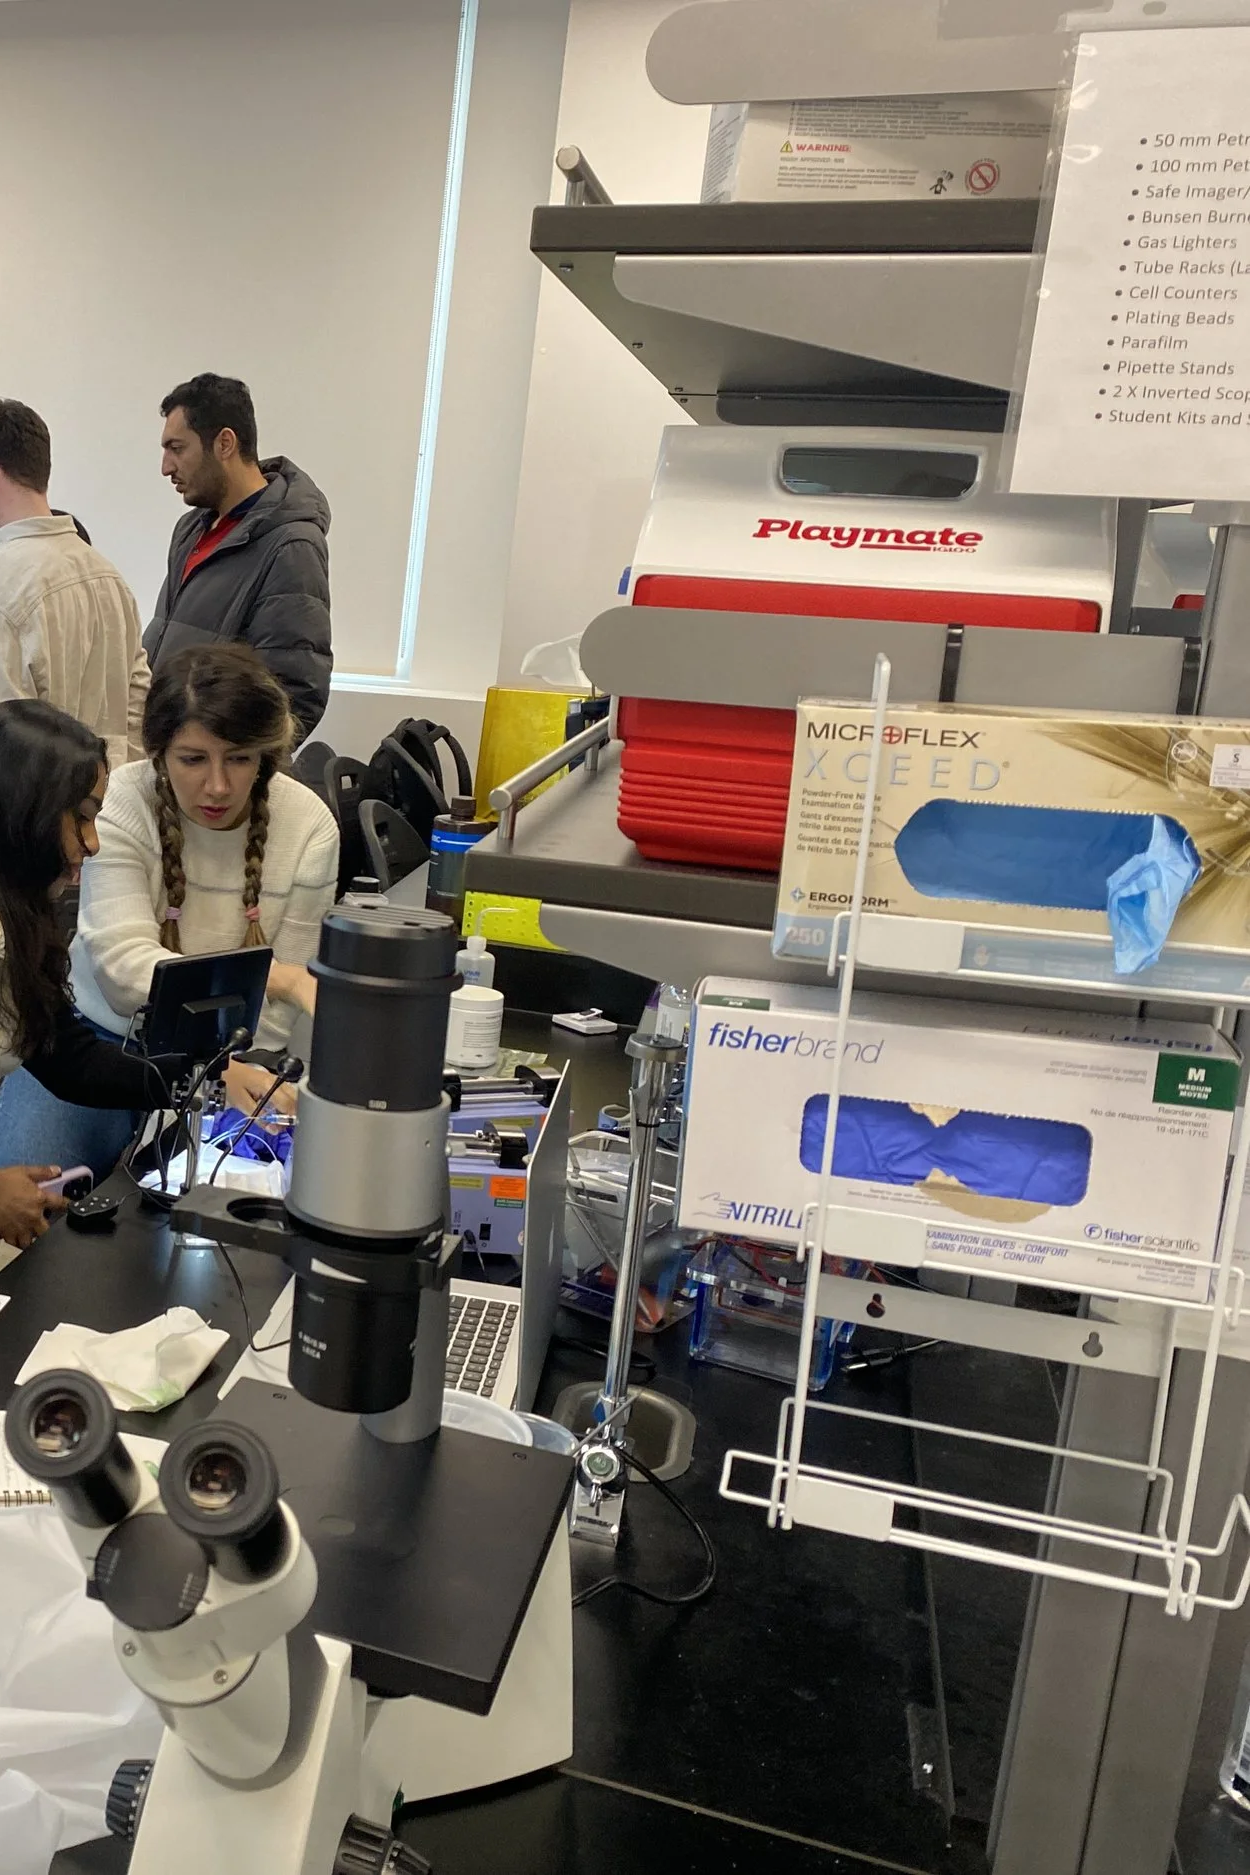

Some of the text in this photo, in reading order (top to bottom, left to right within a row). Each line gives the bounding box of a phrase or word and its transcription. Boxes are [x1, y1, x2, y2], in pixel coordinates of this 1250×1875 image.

[1153, 132, 1250, 148] 50 mm Petr
[1150, 158, 1250, 173] 100 mm Pet
[1145, 184, 1250, 201] Safe Imager/
[1142, 210, 1202, 224] Bunsen
[1137, 234, 1238, 252] Gas Lighters
[1134, 259, 1250, 277] Tube Racks (La
[1129, 285, 1238, 300] Cell Counters
[1125, 310, 1235, 327] Plating Beads
[1121, 334, 1188, 350] Parafilm
[1117, 360, 1235, 376] Pipette Stands
[1112, 385, 1122, 398] 2
[1127, 385, 1138, 398] X
[1142, 385, 1211, 400] Inverted
[1109, 409, 1172, 423] Student
[1177, 411, 1206, 425] Kits
[1211, 411, 1243, 425] and
[752, 518, 984, 549] Playmate
[804, 748, 1001, 792] XCEED
[802, 788, 854, 800] Powder-Free
[801, 798, 851, 809] Examination
[800, 811, 822, 820] Gants
[798, 821, 821, 830] nitrile
[797, 833, 829, 844] Guantes
[831, 837, 842, 845] de
[834, 847, 848, 856] Sin
[708, 1021, 885, 1064] fisherbrand
[1187, 1066, 1206, 1083] M
[1178, 1083, 1212, 1093] MEDIUM
[1179, 1090, 1209, 1100] MOYEN
[981, 1238, 1017, 1250] GLOVES
[1024, 1244, 1069, 1257] COMFORT
[1104, 1228, 1143, 1244] fisher
[1144, 1234, 1200, 1252] scientific
[931, 1241, 955, 1252] SANS
[957, 1245, 994, 1257] POUDRE
[1003, 1251, 1046, 1265] CONFORT
